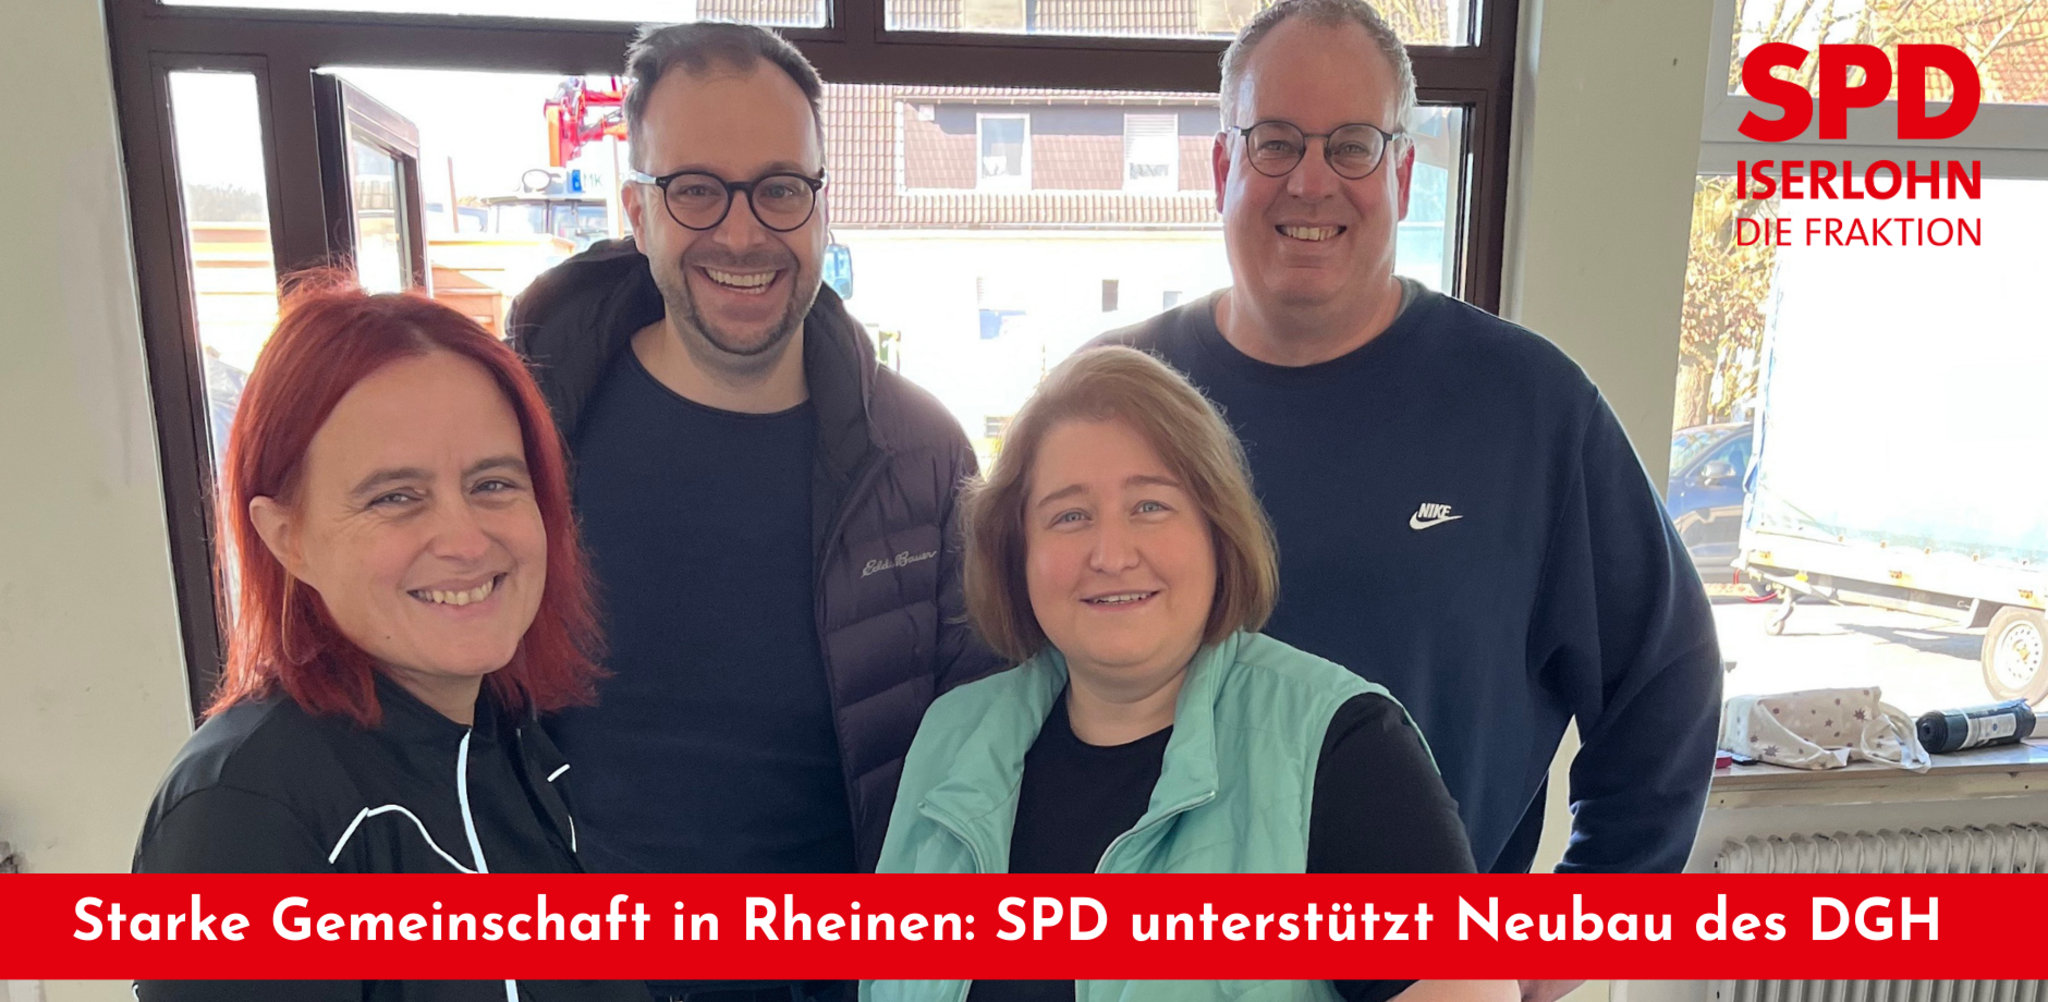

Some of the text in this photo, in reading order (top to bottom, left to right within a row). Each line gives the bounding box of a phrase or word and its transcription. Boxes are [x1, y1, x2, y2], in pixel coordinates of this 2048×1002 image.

[1417, 502, 1452, 519] NIKE
[861, 550, 938, 579] Edd Bauer
